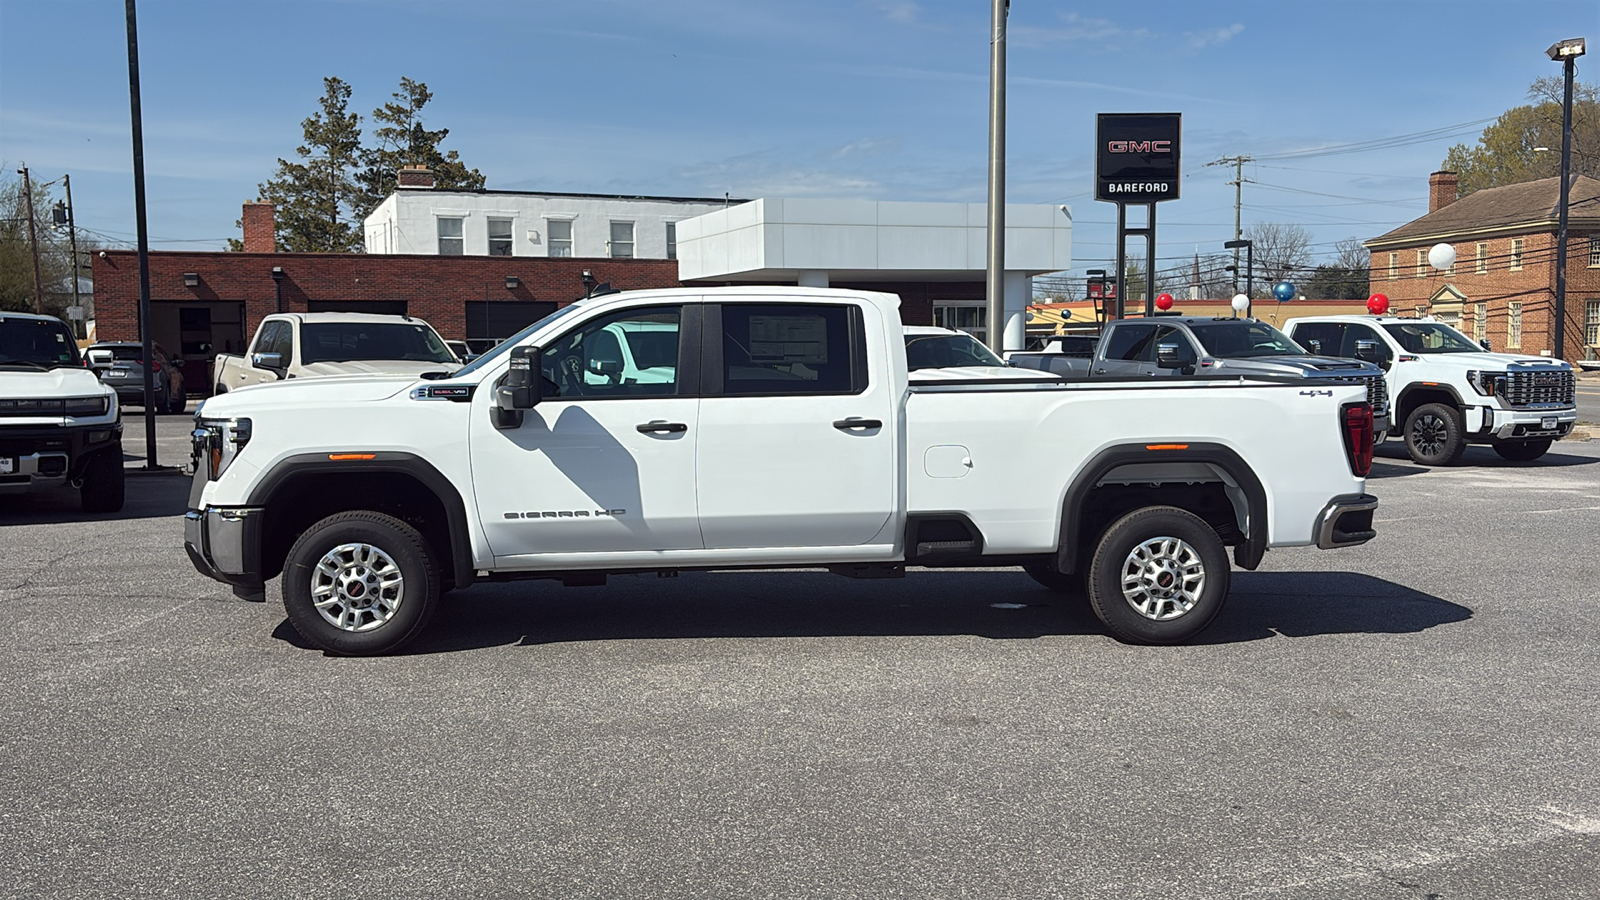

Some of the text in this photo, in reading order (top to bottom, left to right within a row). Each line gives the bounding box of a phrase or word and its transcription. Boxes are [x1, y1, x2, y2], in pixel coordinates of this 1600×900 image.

[1108, 141, 1171, 153] GMC
[1109, 183, 1169, 193] BAREFORD
[504, 510, 590, 519] SIERRA
